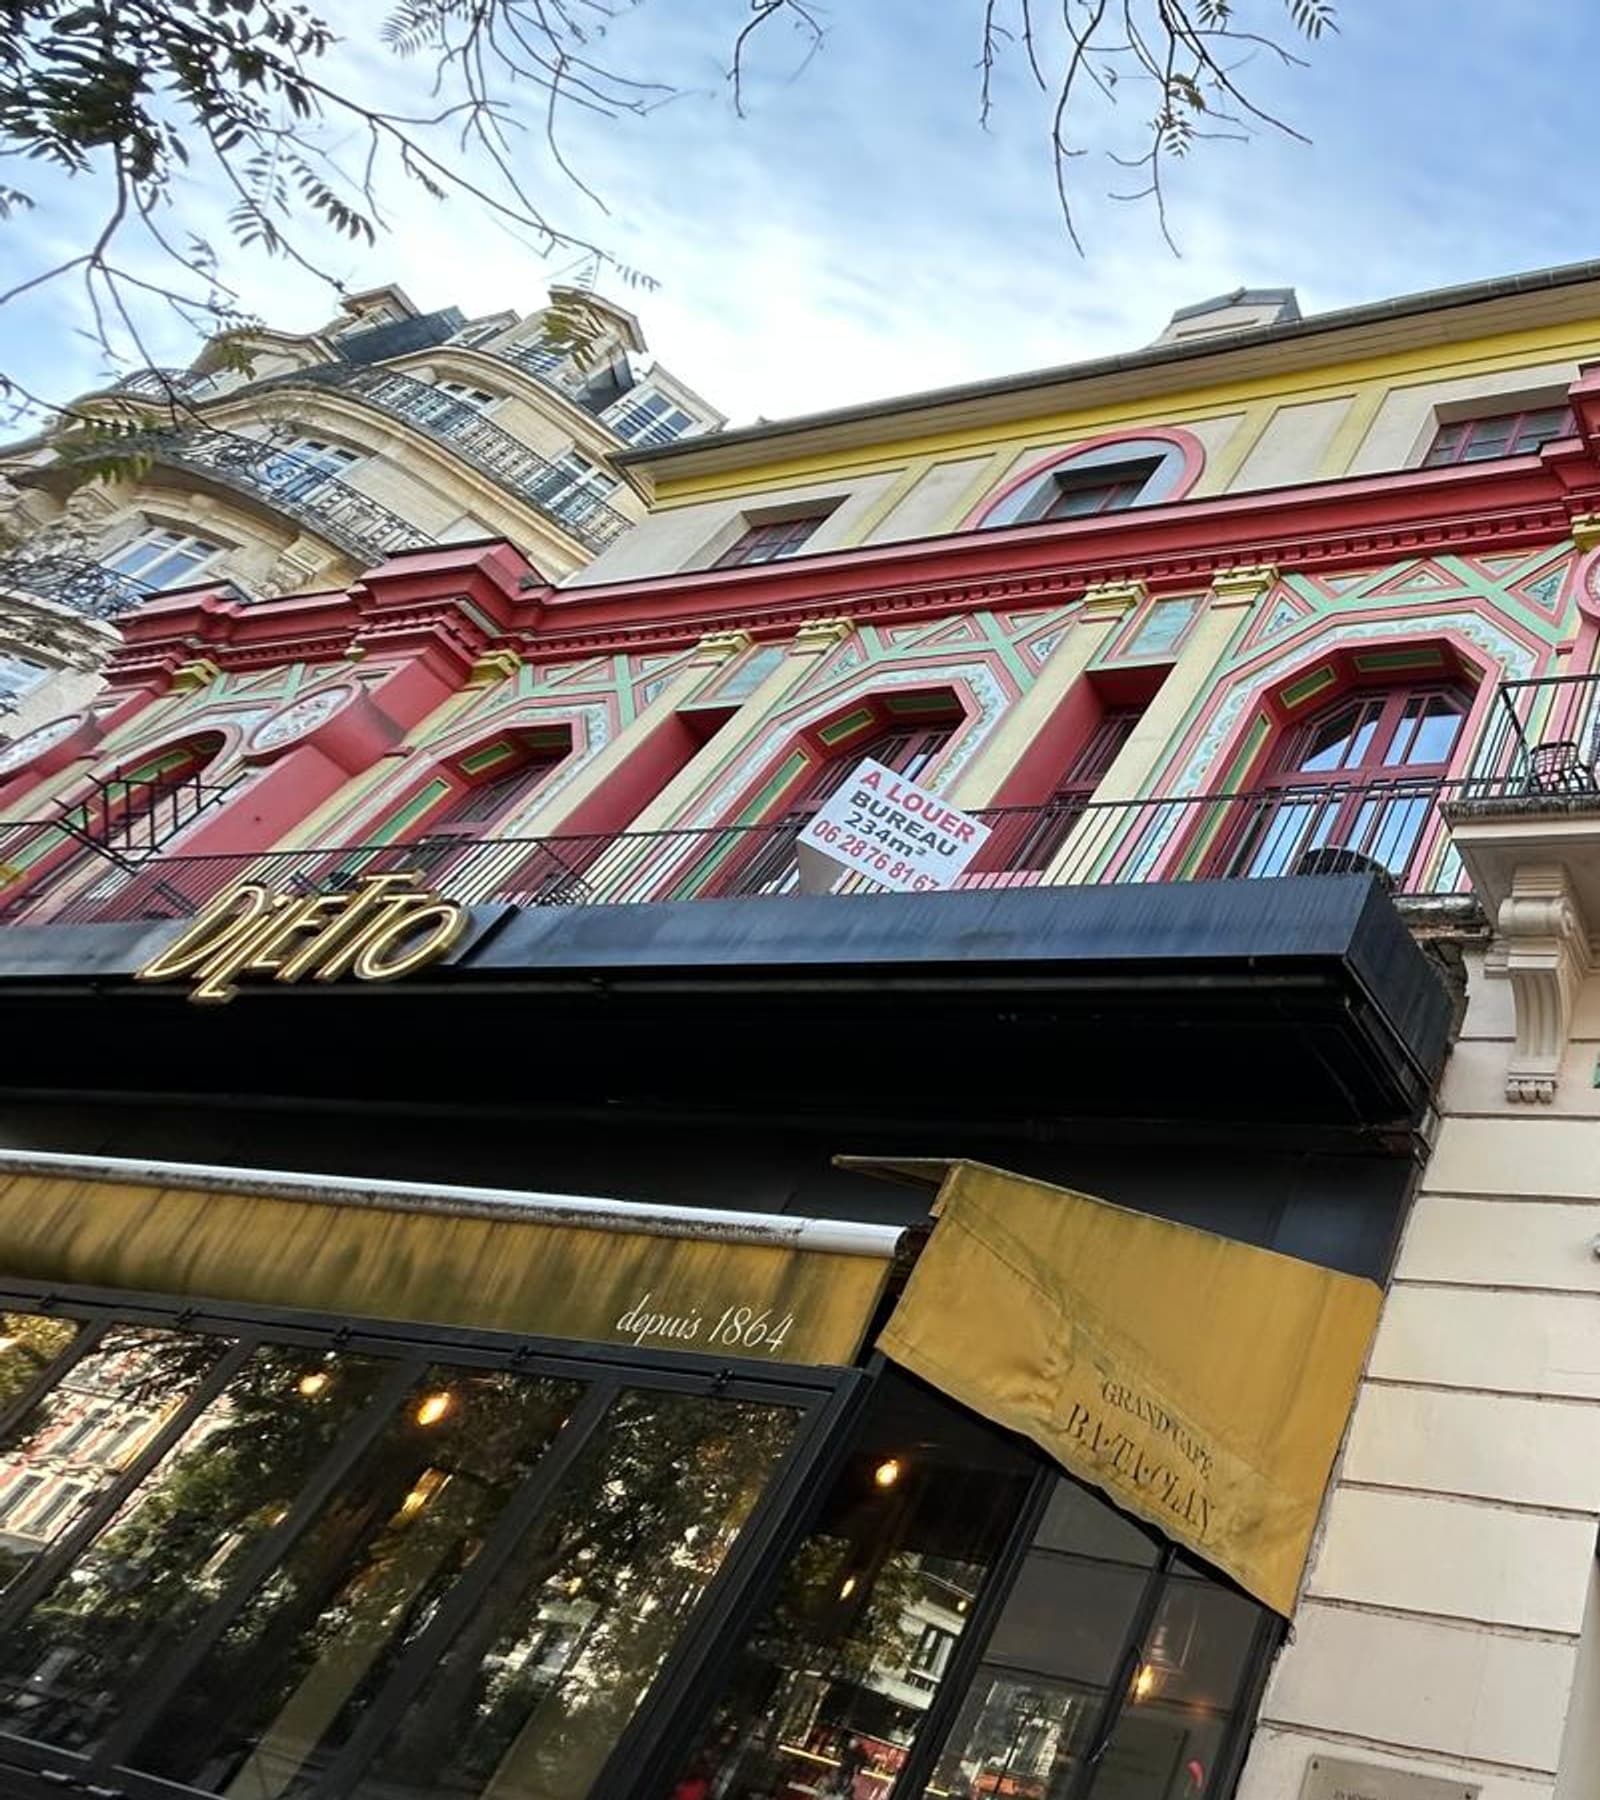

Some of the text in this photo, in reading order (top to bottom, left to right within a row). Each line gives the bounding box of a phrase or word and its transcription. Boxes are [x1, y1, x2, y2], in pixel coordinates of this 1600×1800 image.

[850, 790, 958, 856] BUREAU
[860, 771, 976, 843] A LOUER
[616, 1292, 794, 1352] depuis 1864
[1101, 1379, 1170, 1433] GRAND
